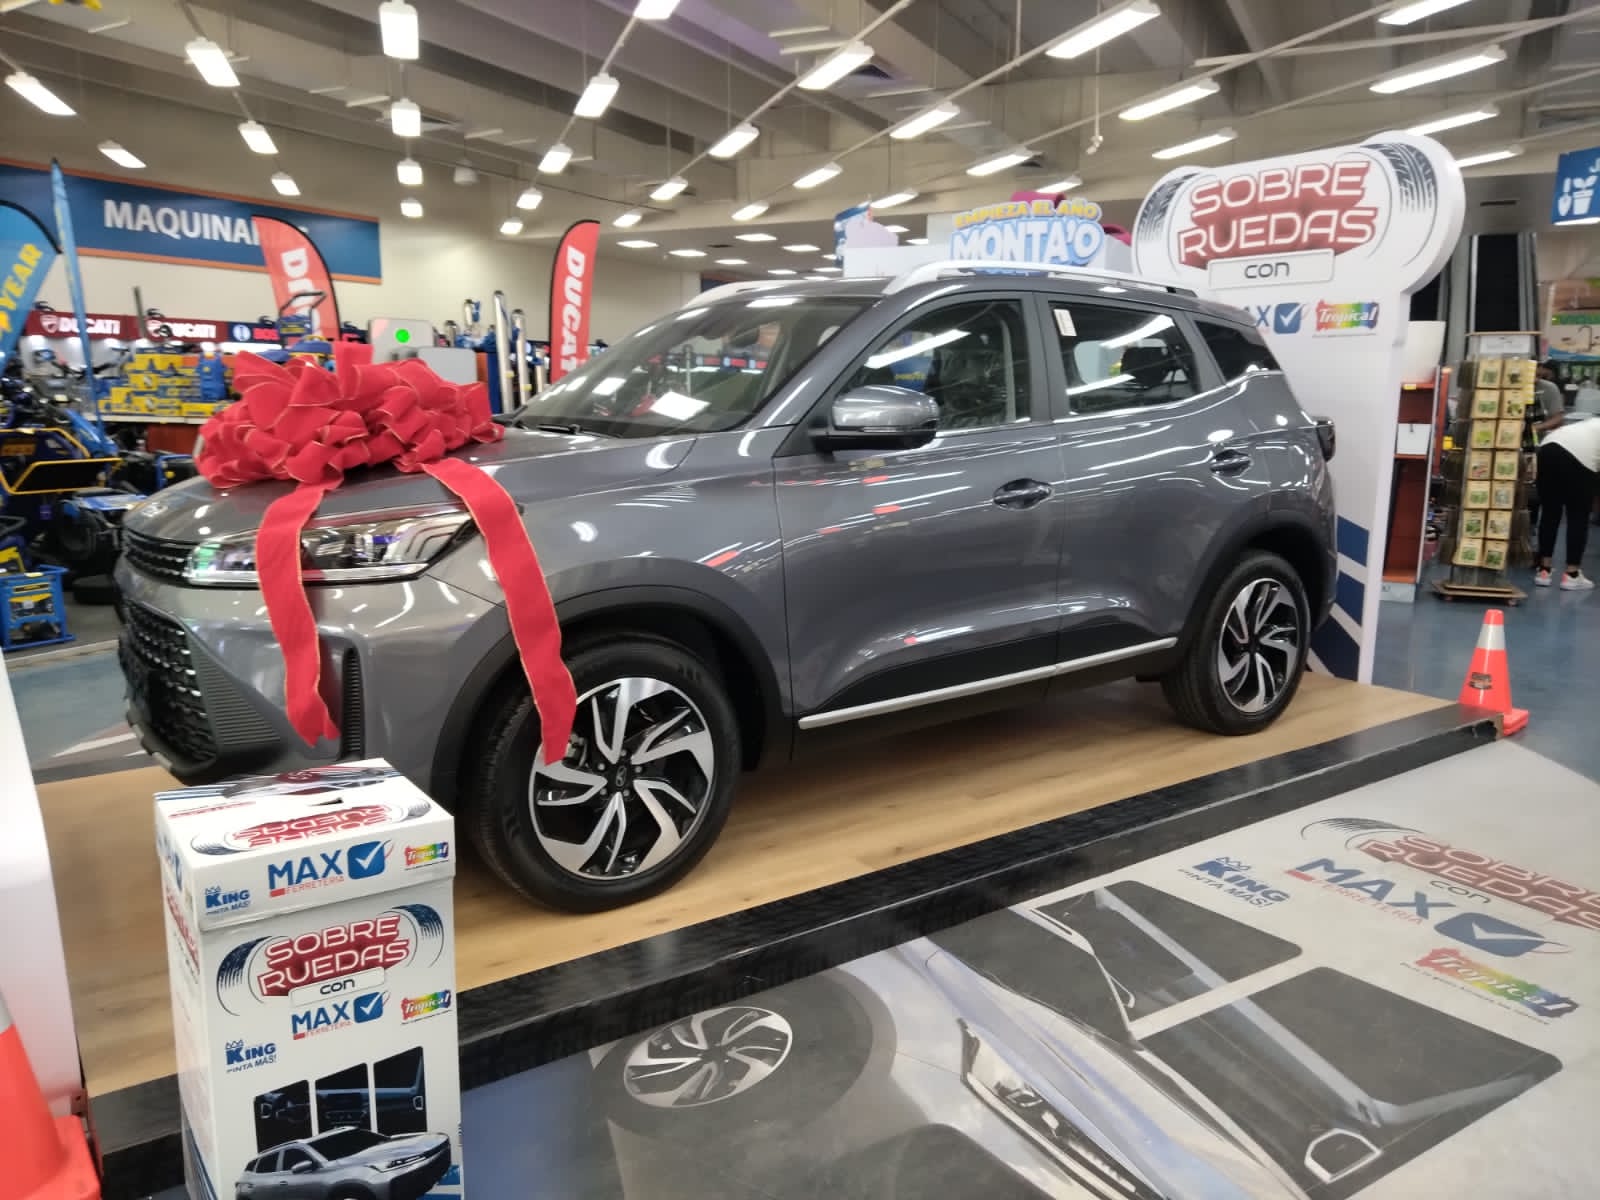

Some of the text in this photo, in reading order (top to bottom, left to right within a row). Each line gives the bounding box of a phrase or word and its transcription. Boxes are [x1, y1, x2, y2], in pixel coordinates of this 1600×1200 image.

[1190, 160, 1371, 218] SOBRE
[1032, 201, 1053, 215] EL
[1056, 199, 1098, 218] AÑO
[1178, 209, 1377, 263] RUEDAS
[1243, 261, 1291, 280] con
[560, 245, 586, 373] DUCAT
[1318, 305, 1378, 328] Tropical
[268, 849, 343, 890] MAX
[1192, 860, 1291, 902] KING
[205, 889, 250, 909] KING
[1295, 858, 1456, 920] MAX
[1430, 879, 1491, 904] con
[266, 916, 400, 965] SOBRE
[258, 940, 408, 995] RUEDAS
[320, 978, 355, 995] con
[291, 1000, 350, 1034] MAX
[226, 1042, 276, 1065] KING
